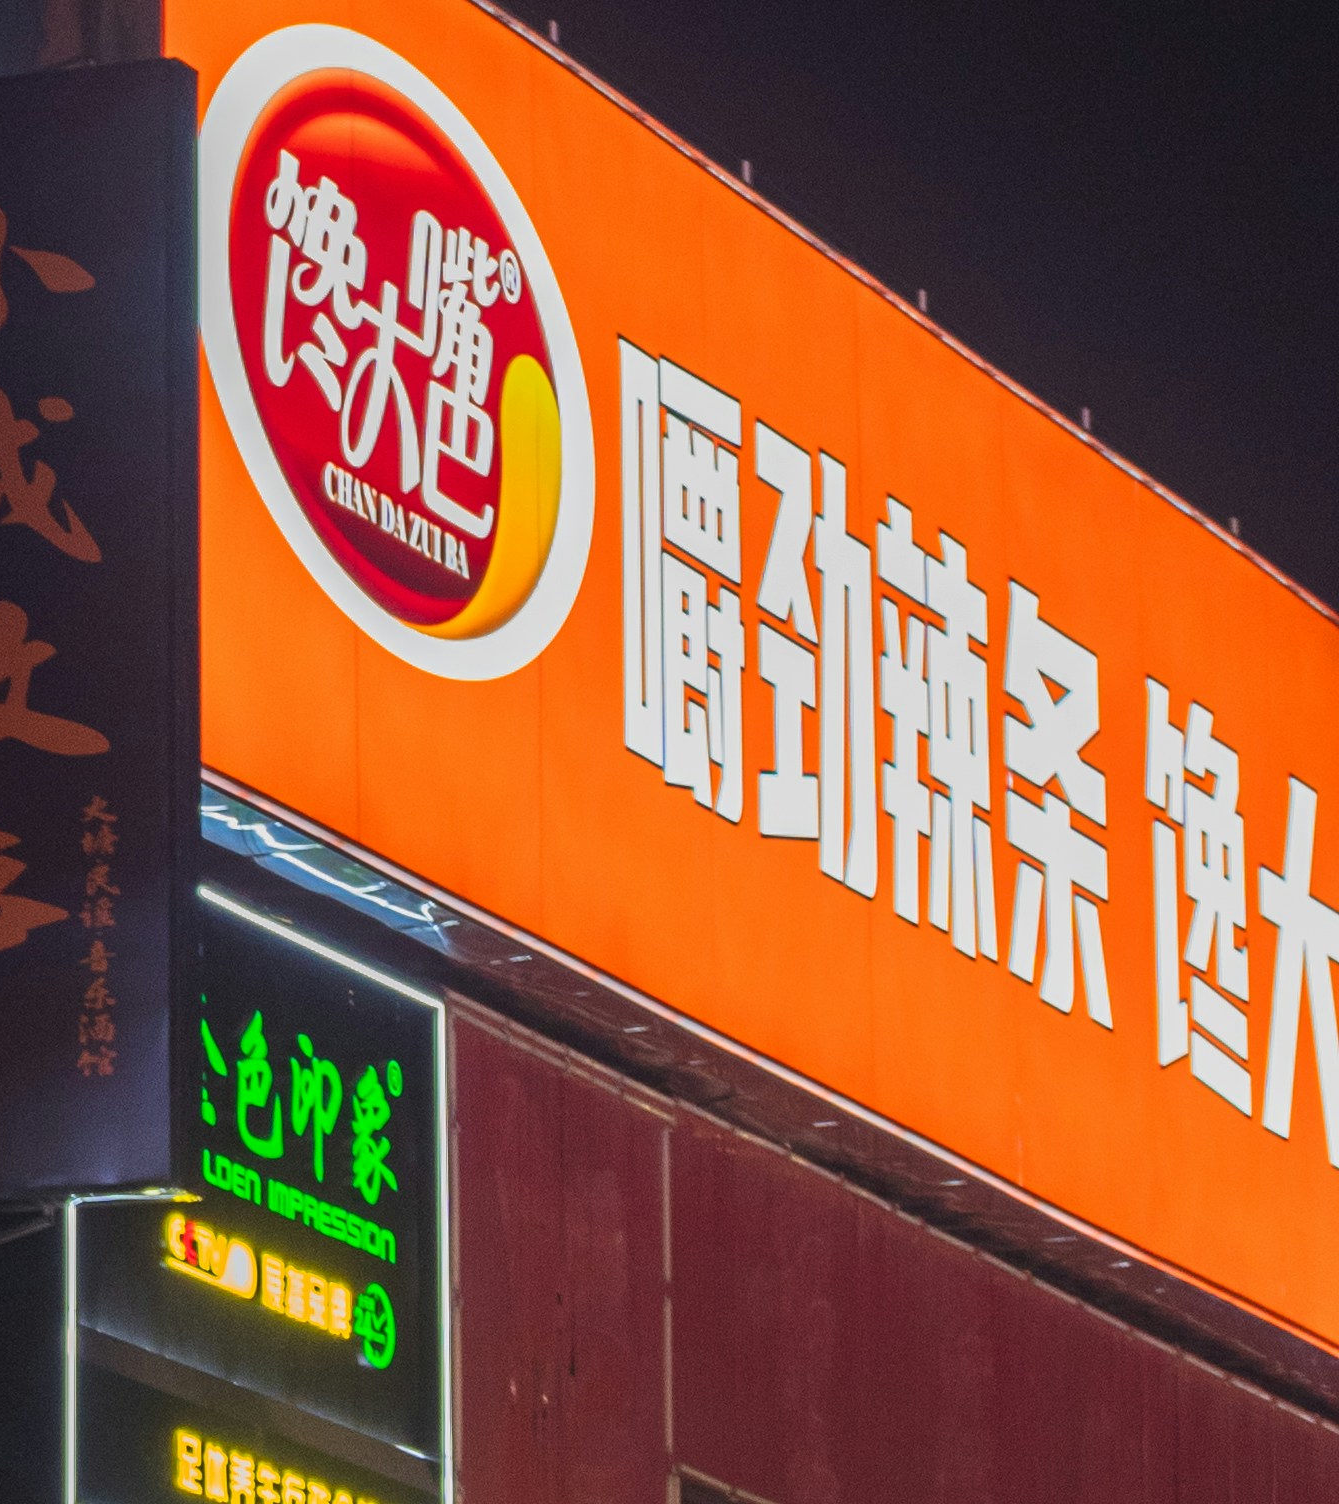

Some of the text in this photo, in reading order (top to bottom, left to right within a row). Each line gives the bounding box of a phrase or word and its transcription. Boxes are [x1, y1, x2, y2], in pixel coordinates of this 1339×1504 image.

[325, 462, 470, 581] CHAN DA ZUI BA
[618, 333, 1113, 1031] 嚼劲辣条
[267, 1179, 395, 1264] IMPRESSION
